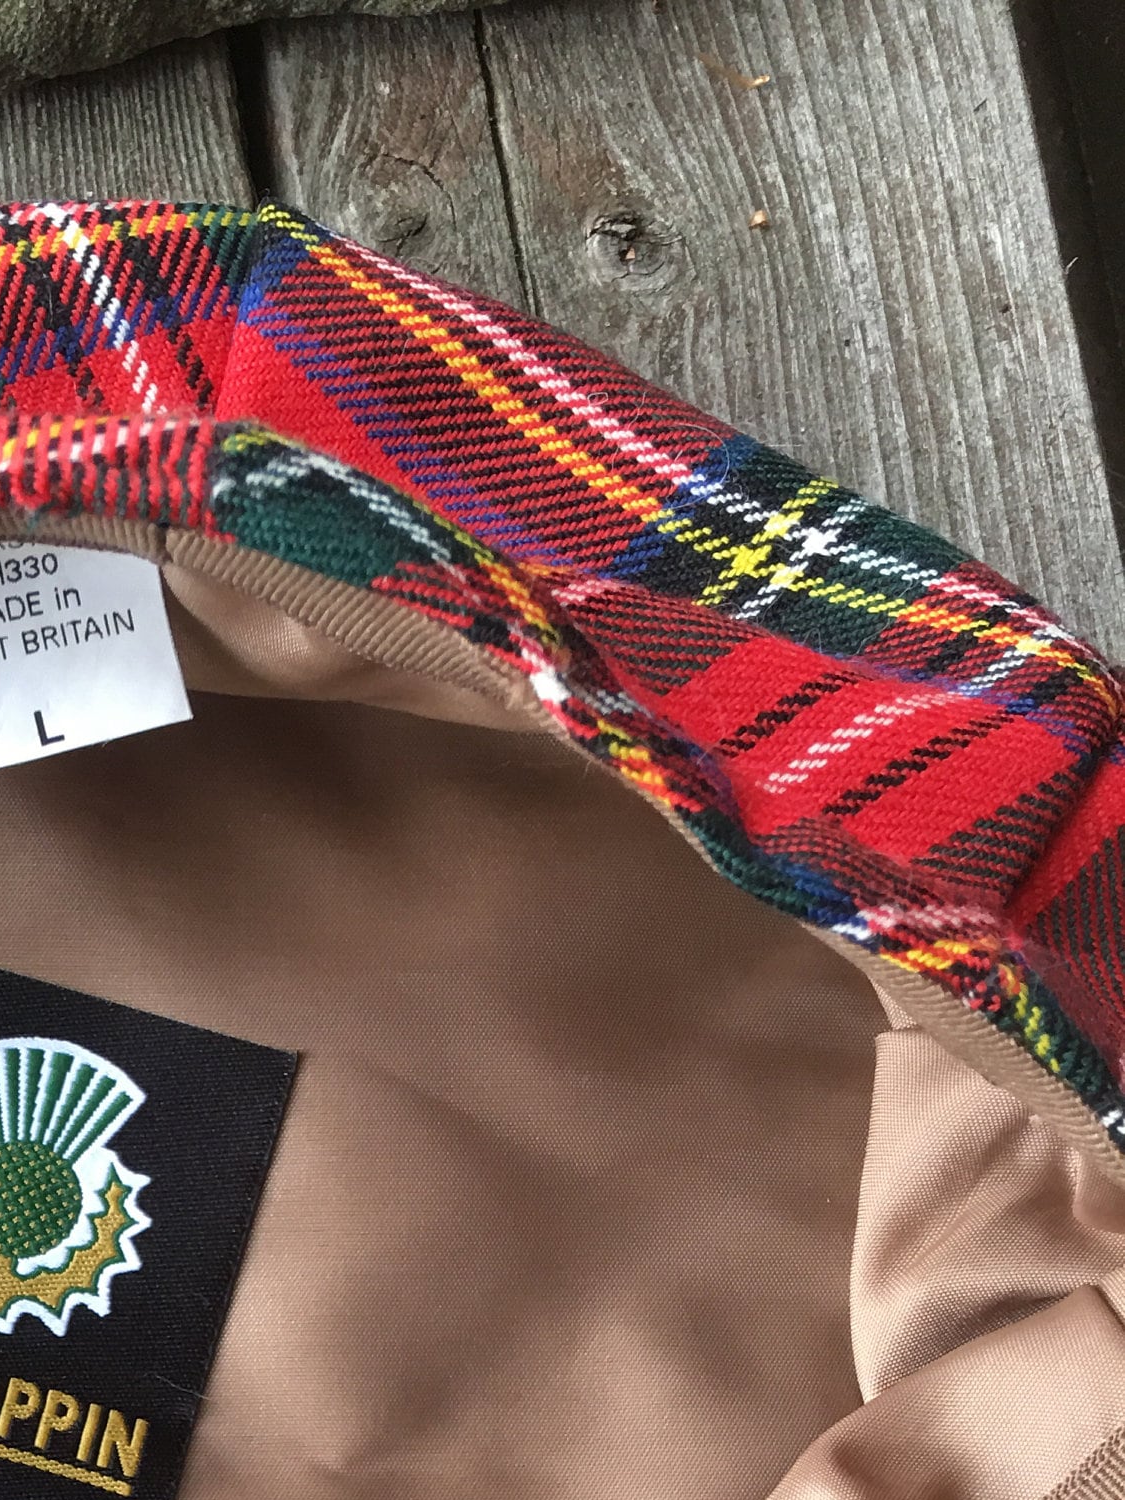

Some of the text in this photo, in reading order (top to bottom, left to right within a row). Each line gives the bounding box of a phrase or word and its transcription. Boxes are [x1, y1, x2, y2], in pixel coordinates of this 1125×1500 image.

[54, 586, 82, 611] in
[21, 608, 135, 655] BRITAIN
[33, 709, 65, 746] L
